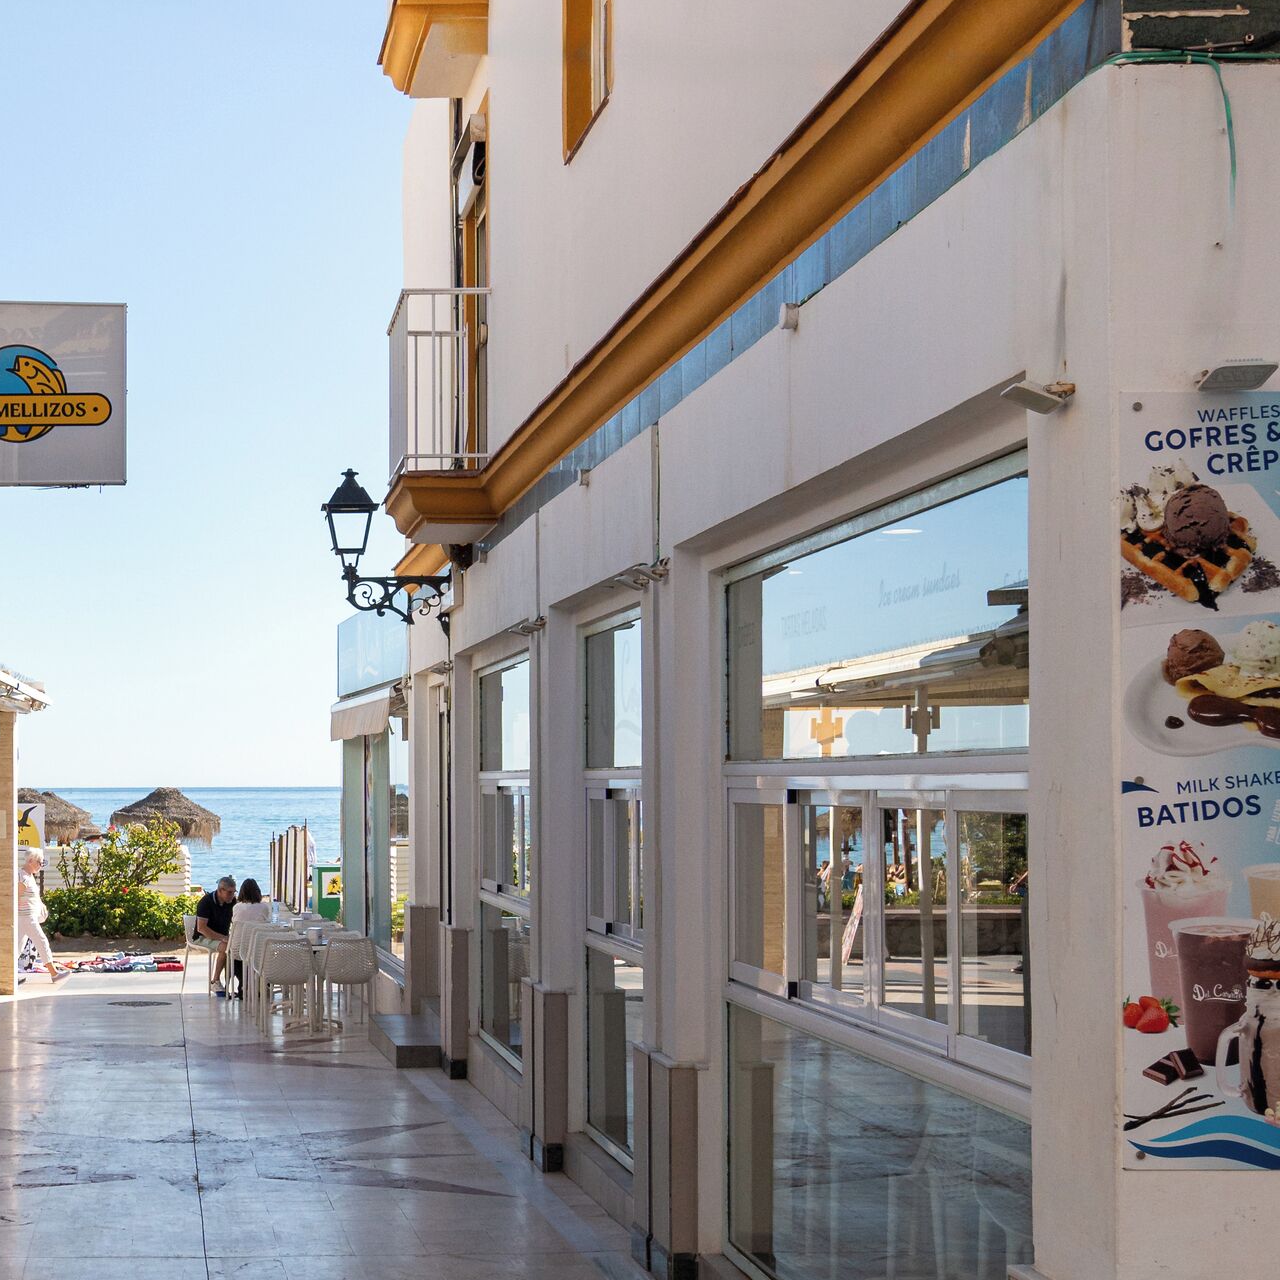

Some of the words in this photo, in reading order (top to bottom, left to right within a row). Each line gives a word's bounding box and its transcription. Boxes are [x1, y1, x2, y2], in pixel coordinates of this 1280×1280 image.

[1197, 405, 1280, 423] WAFFLES
[1144, 423, 1257, 451] GOFRES
[1176, 777, 1220, 795] MILK
[1137, 794, 1261, 828] BATIDOS
